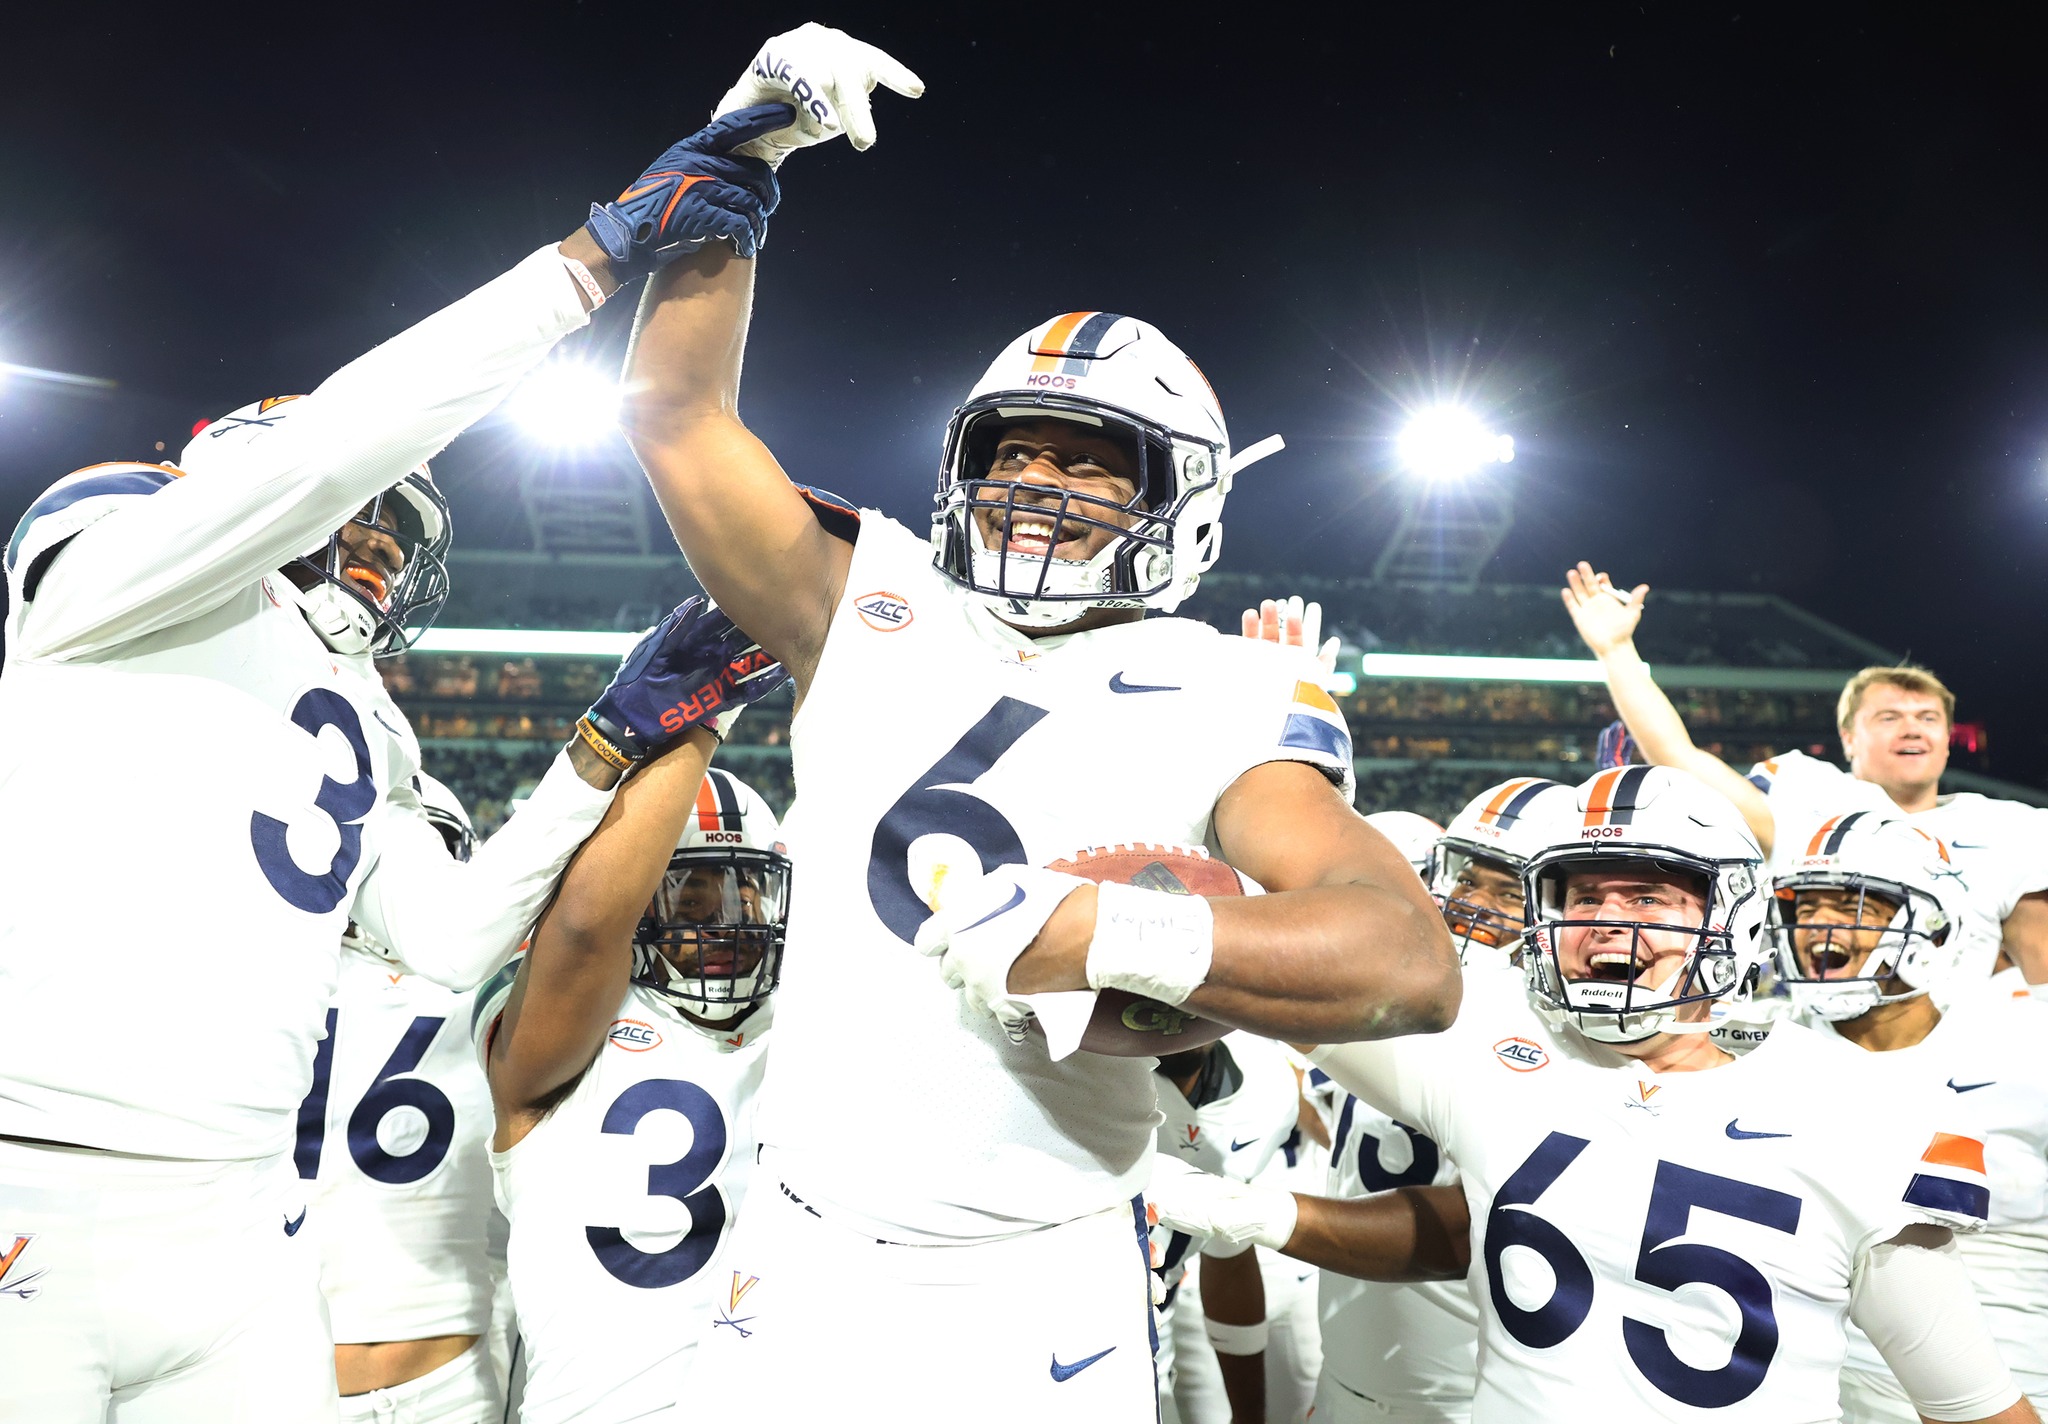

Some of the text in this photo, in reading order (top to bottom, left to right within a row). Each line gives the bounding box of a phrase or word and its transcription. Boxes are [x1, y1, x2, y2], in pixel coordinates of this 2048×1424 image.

[1026, 374, 1077, 390] HOOS
[864, 600, 908, 620] ACC
[250, 687, 378, 914] 3
[867, 695, 1051, 946] 6
[705, 832, 743, 844] HOOS
[1581, 827, 1623, 839] HOOS
[708, 986, 736, 994] Ridde
[1580, 988, 1624, 999] Riddell
[613, 1026, 655, 1041] ACC
[1731, 1030, 1770, 1042] GIVEN
[1501, 1044, 1543, 1062] ACC
[585, 1078, 728, 1289] 3
[1484, 1130, 1803, 1409] 65
